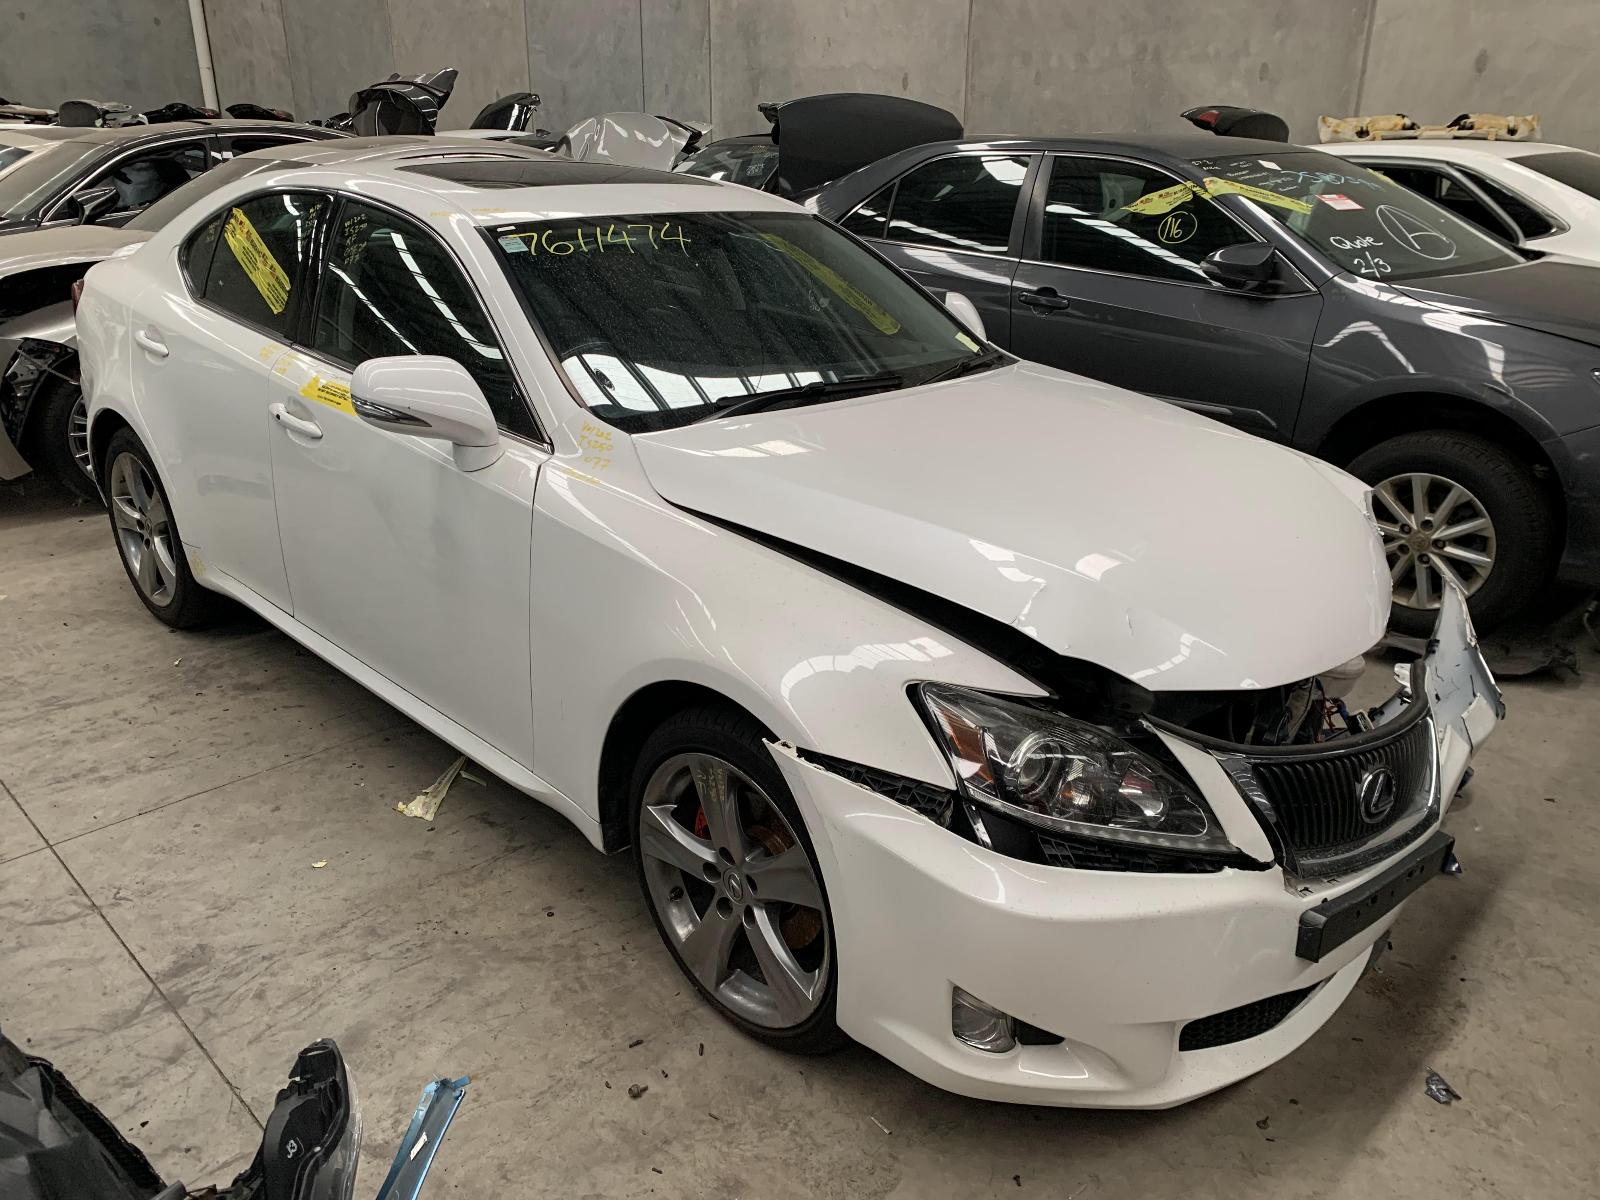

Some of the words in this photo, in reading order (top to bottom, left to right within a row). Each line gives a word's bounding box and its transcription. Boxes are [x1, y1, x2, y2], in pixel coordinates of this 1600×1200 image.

[500, 222, 691, 258] 7611474
[1330, 235, 1384, 250] Quote
[1353, 251, 1392, 278] 2/3
